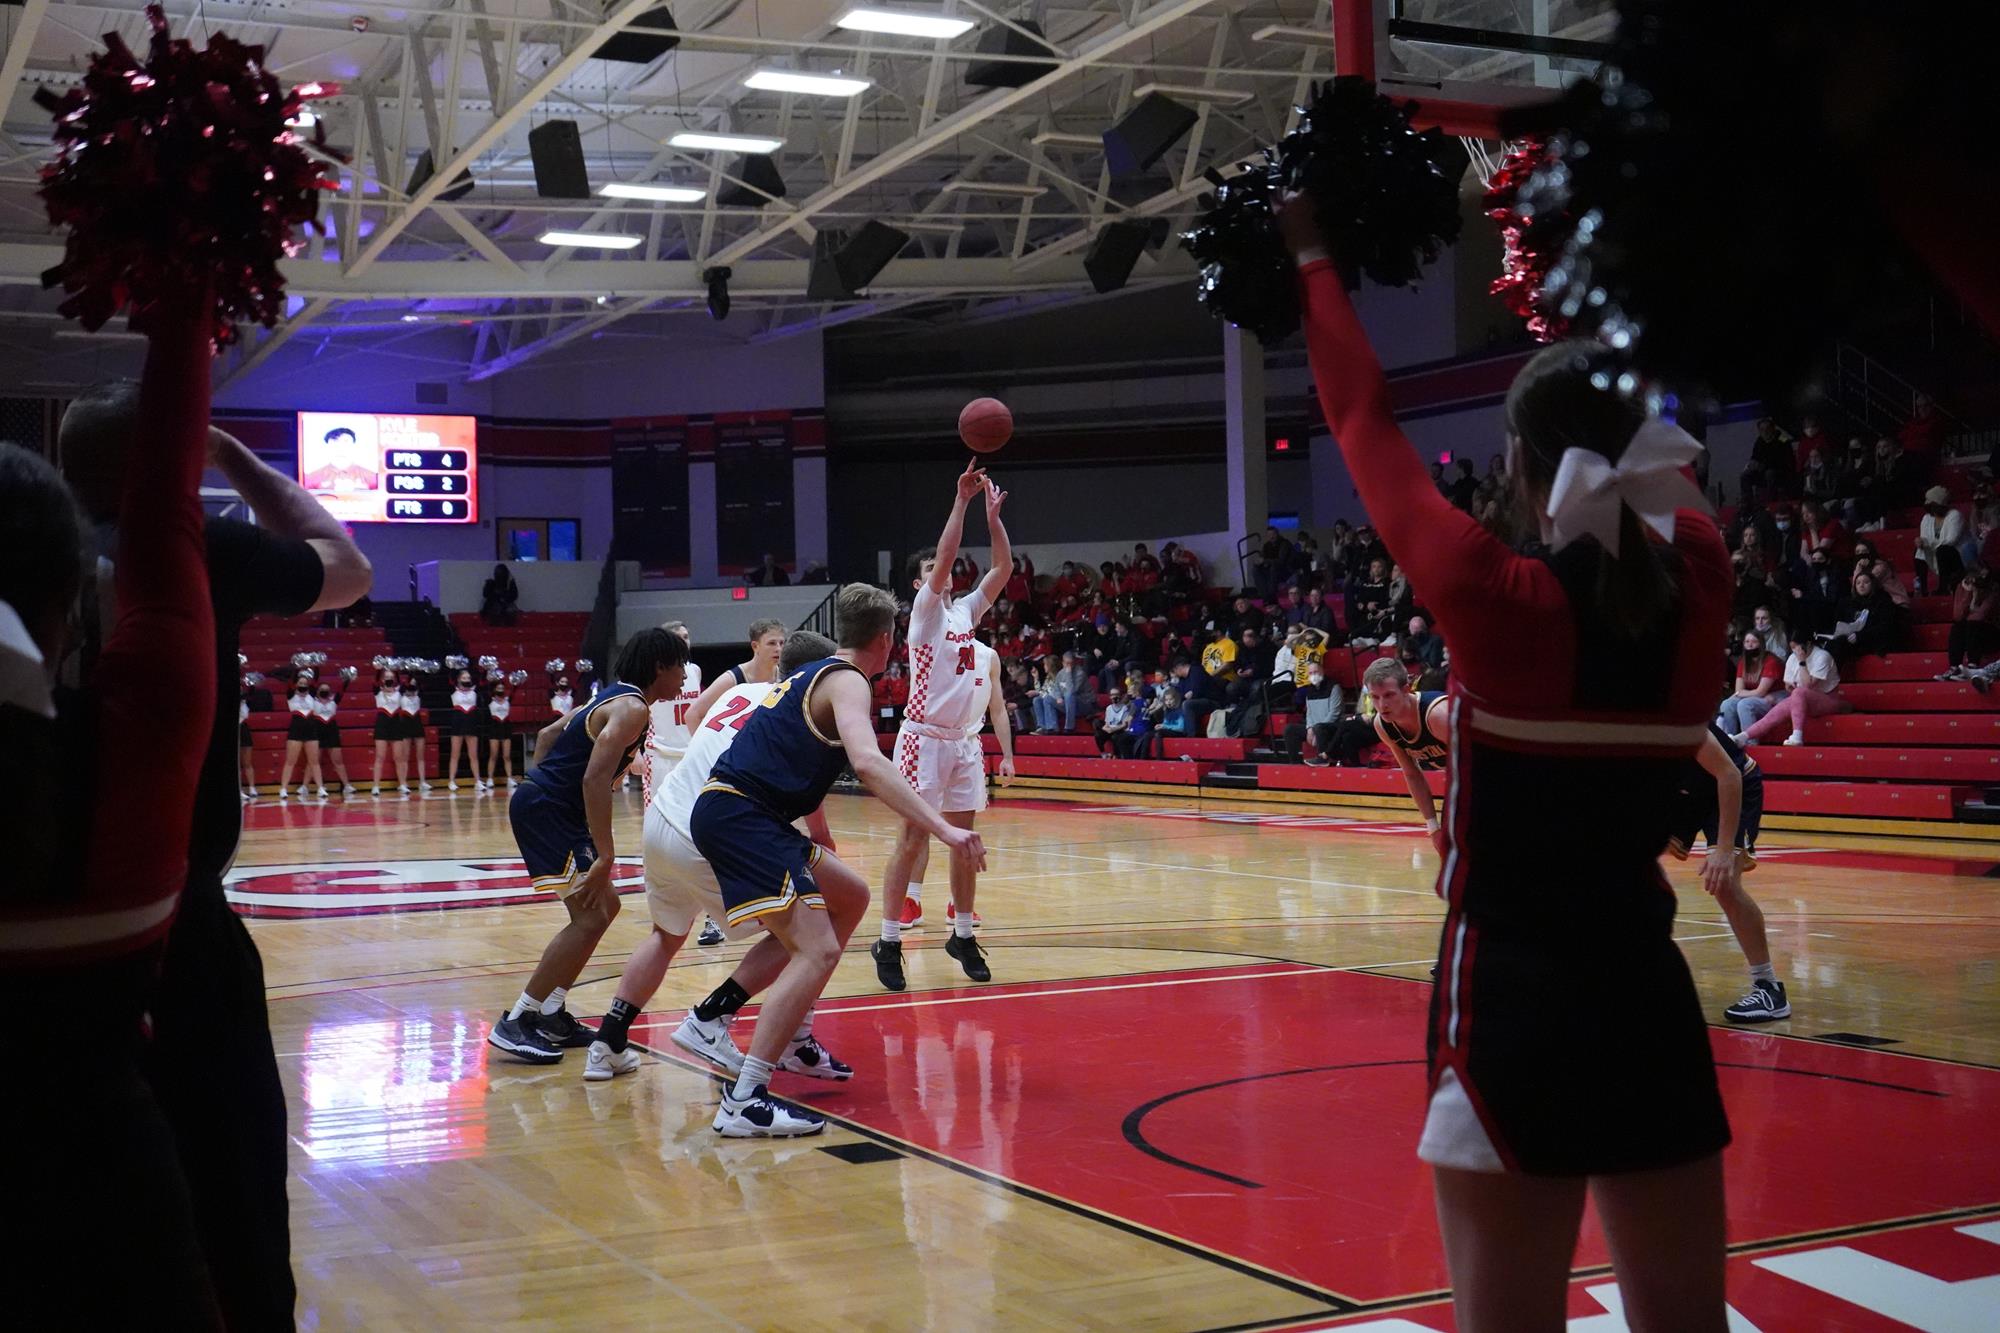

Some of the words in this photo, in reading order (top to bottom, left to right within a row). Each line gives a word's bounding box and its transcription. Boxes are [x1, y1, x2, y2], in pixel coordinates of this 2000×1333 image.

[393, 453, 422, 467] PTS
[441, 454, 452, 467] 4
[442, 476, 453, 490] 2
[442, 501, 453, 515] 0
